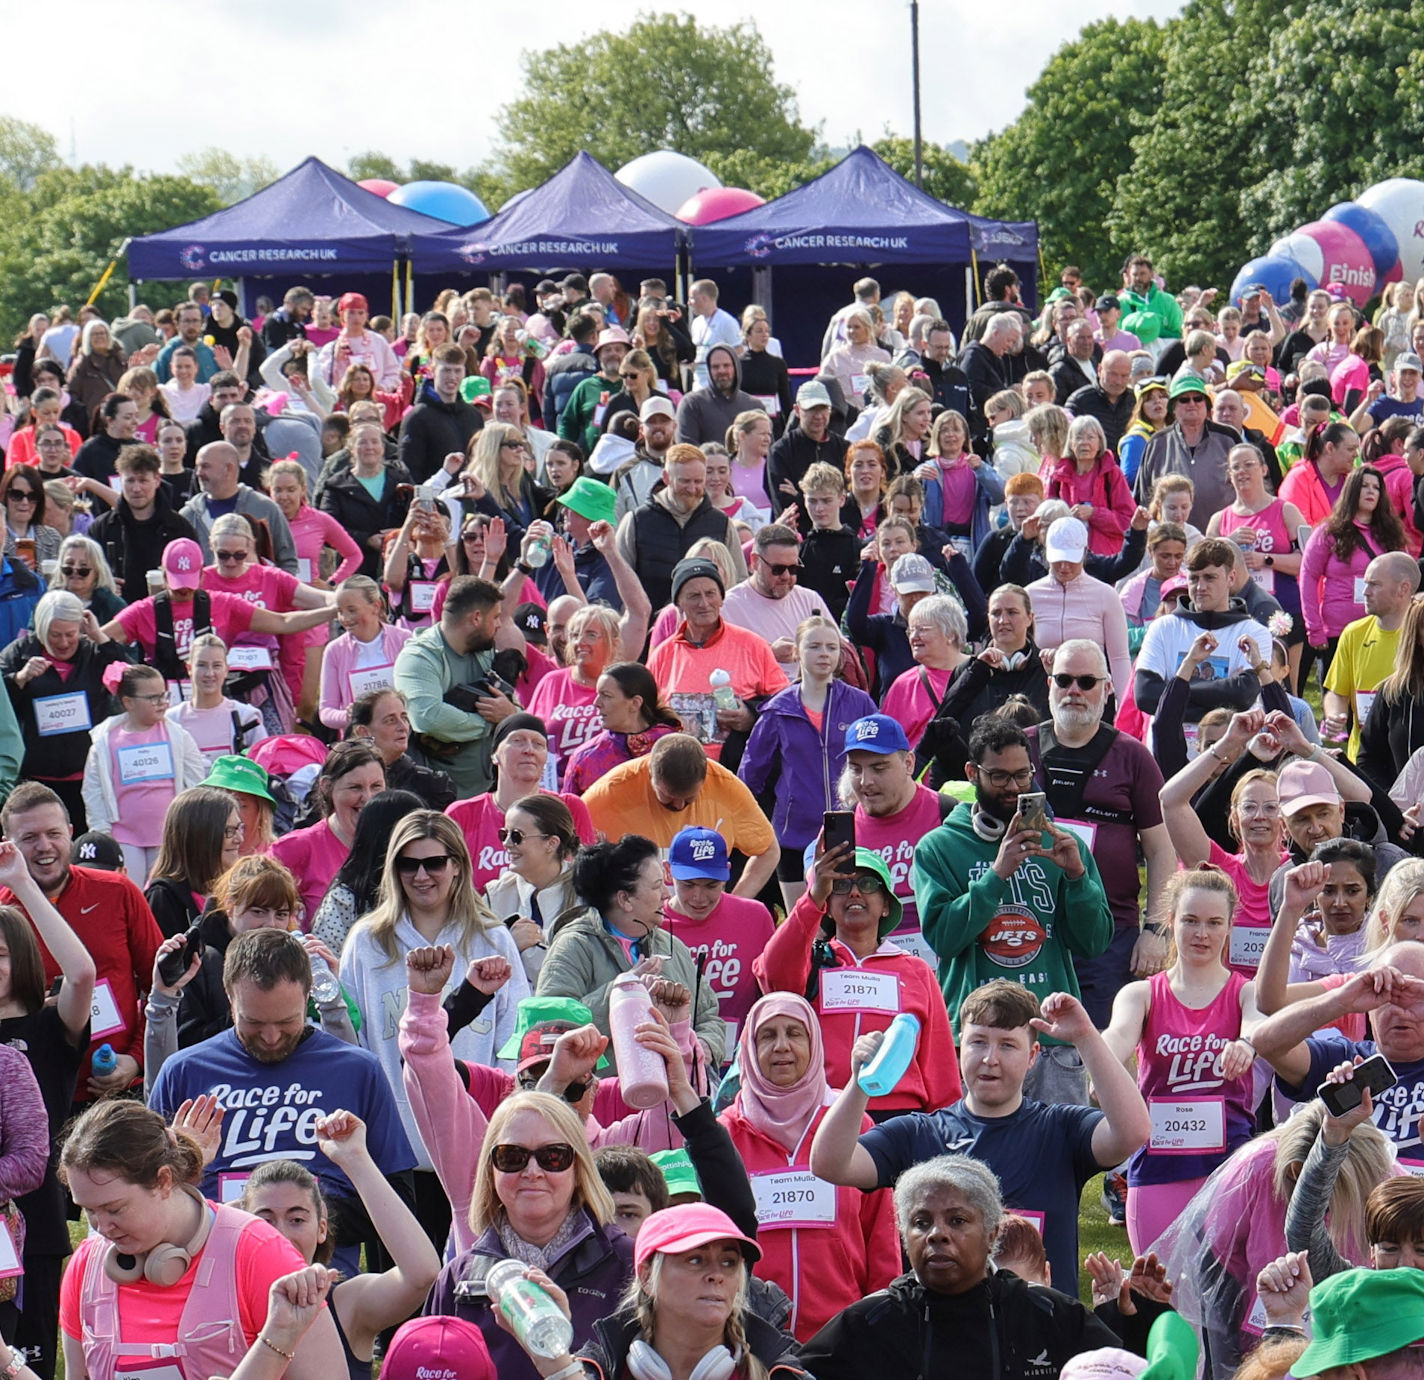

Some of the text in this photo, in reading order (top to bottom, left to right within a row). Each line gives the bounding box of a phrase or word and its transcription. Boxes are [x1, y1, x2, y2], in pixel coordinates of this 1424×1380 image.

[489, 242, 618, 255] CANCER RESEARCH UK
[775, 236, 907, 249] CANCER RESEARCH UK
[210, 249, 337, 262] CANCER RESEARCH UK
[1330, 263, 1375, 289] Finish
[526, 614, 539, 629] NY
[551, 703, 593, 720] Race
[858, 724, 879, 739] Life
[133, 756, 159, 768] 40126
[80, 843, 97, 860] NY
[693, 845, 715, 858] Life
[990, 930, 1038, 943] JETS
[711, 940, 738, 959] for
[843, 984, 878, 997] 21871
[1155, 1032, 1229, 1056] Race for
[1167, 1050, 1227, 1086] Life
[208, 1082, 322, 1112] Race for
[1176, 1105, 1194, 1114] Rose
[222, 1106, 327, 1158] Life
[1165, 1119, 1206, 1132] 20432
[770, 1174, 817, 1184] Team Mulla
[772, 1189, 815, 1204] 21870
[416, 1366, 456, 1379] Race for
